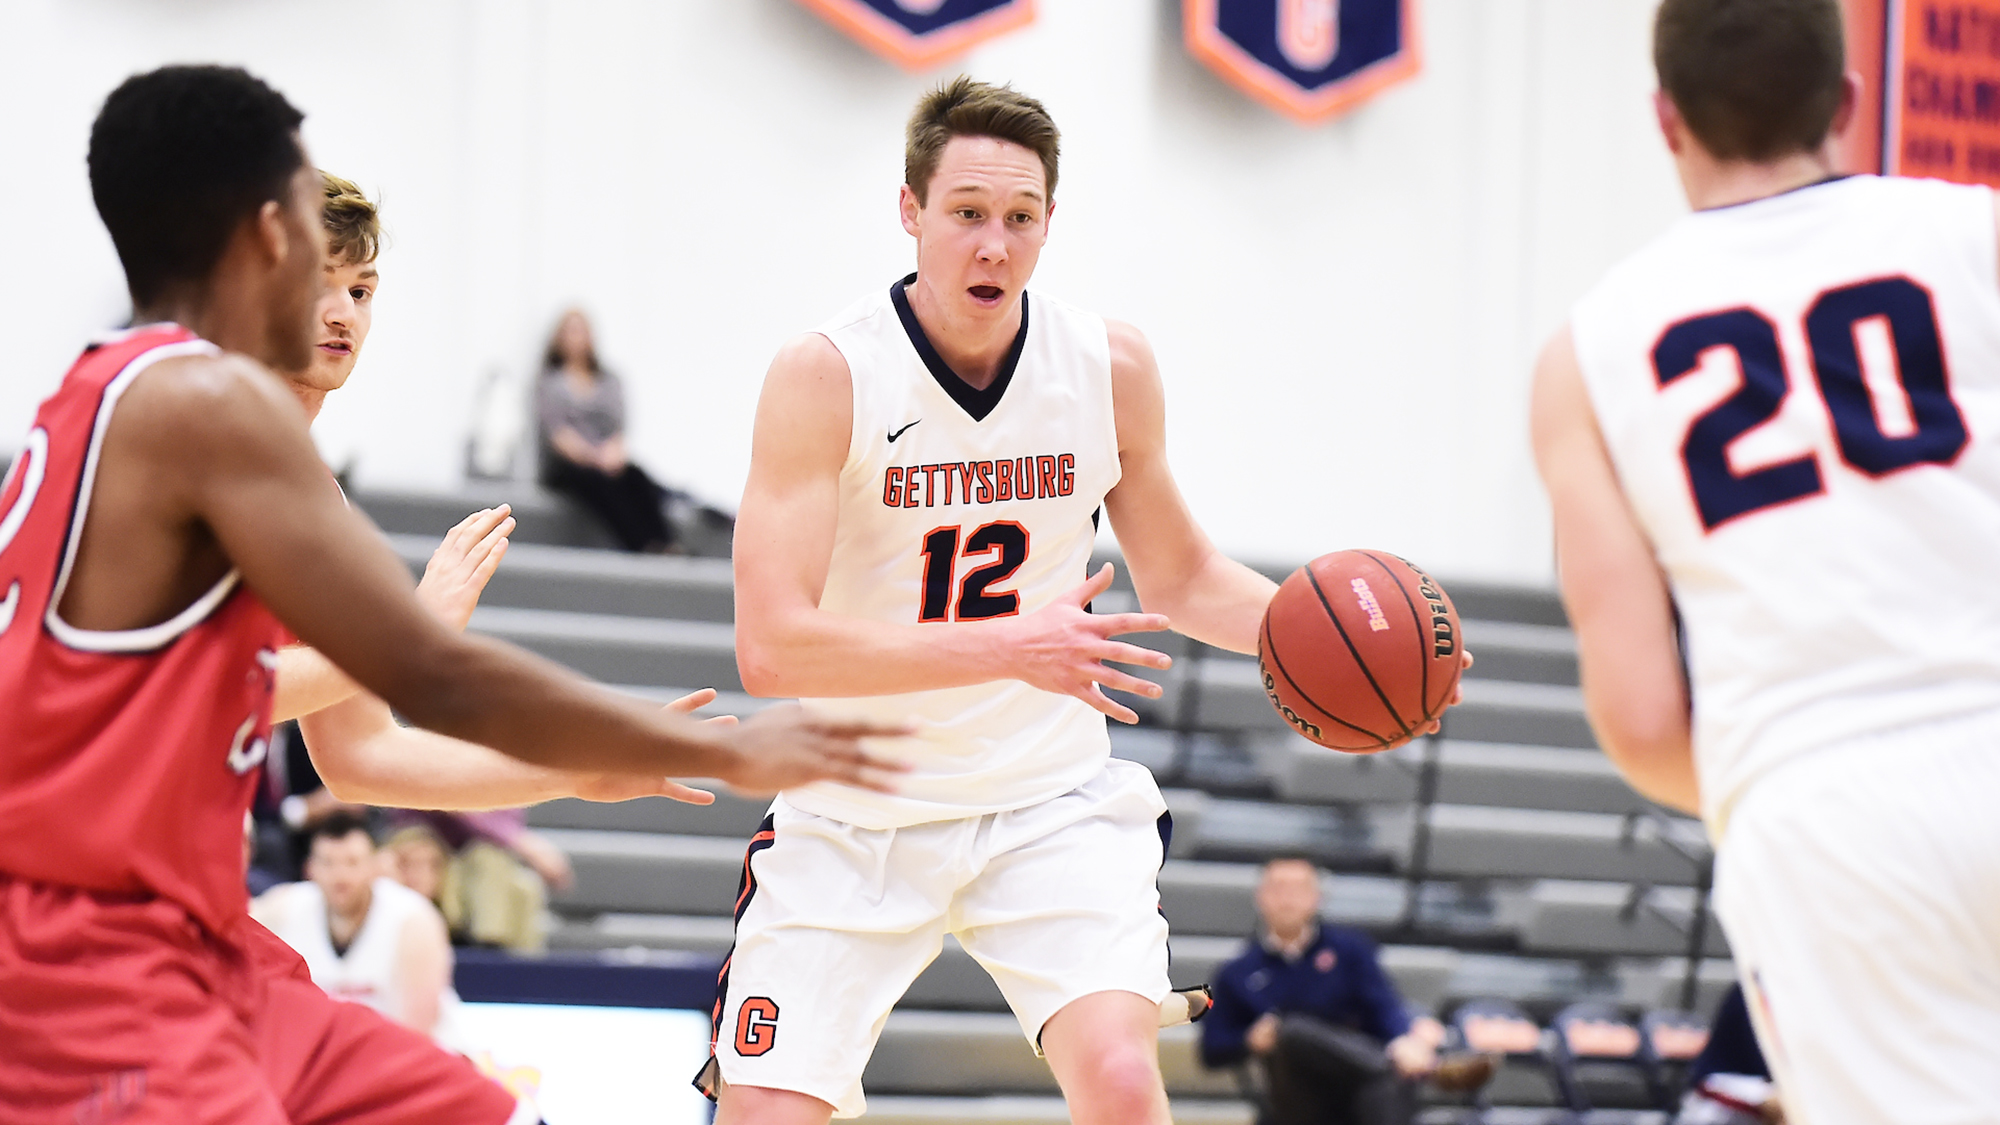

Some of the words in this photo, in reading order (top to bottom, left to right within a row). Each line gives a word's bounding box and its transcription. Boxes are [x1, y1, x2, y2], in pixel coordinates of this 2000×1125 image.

[1648, 273, 1971, 535] 20
[883, 453, 1075, 508] GETTYSBURG
[918, 519, 1030, 623] 12
[1350, 577, 1390, 632] Bullets
[1402, 557, 1455, 661] Wilso
[734, 996, 780, 1057] G
